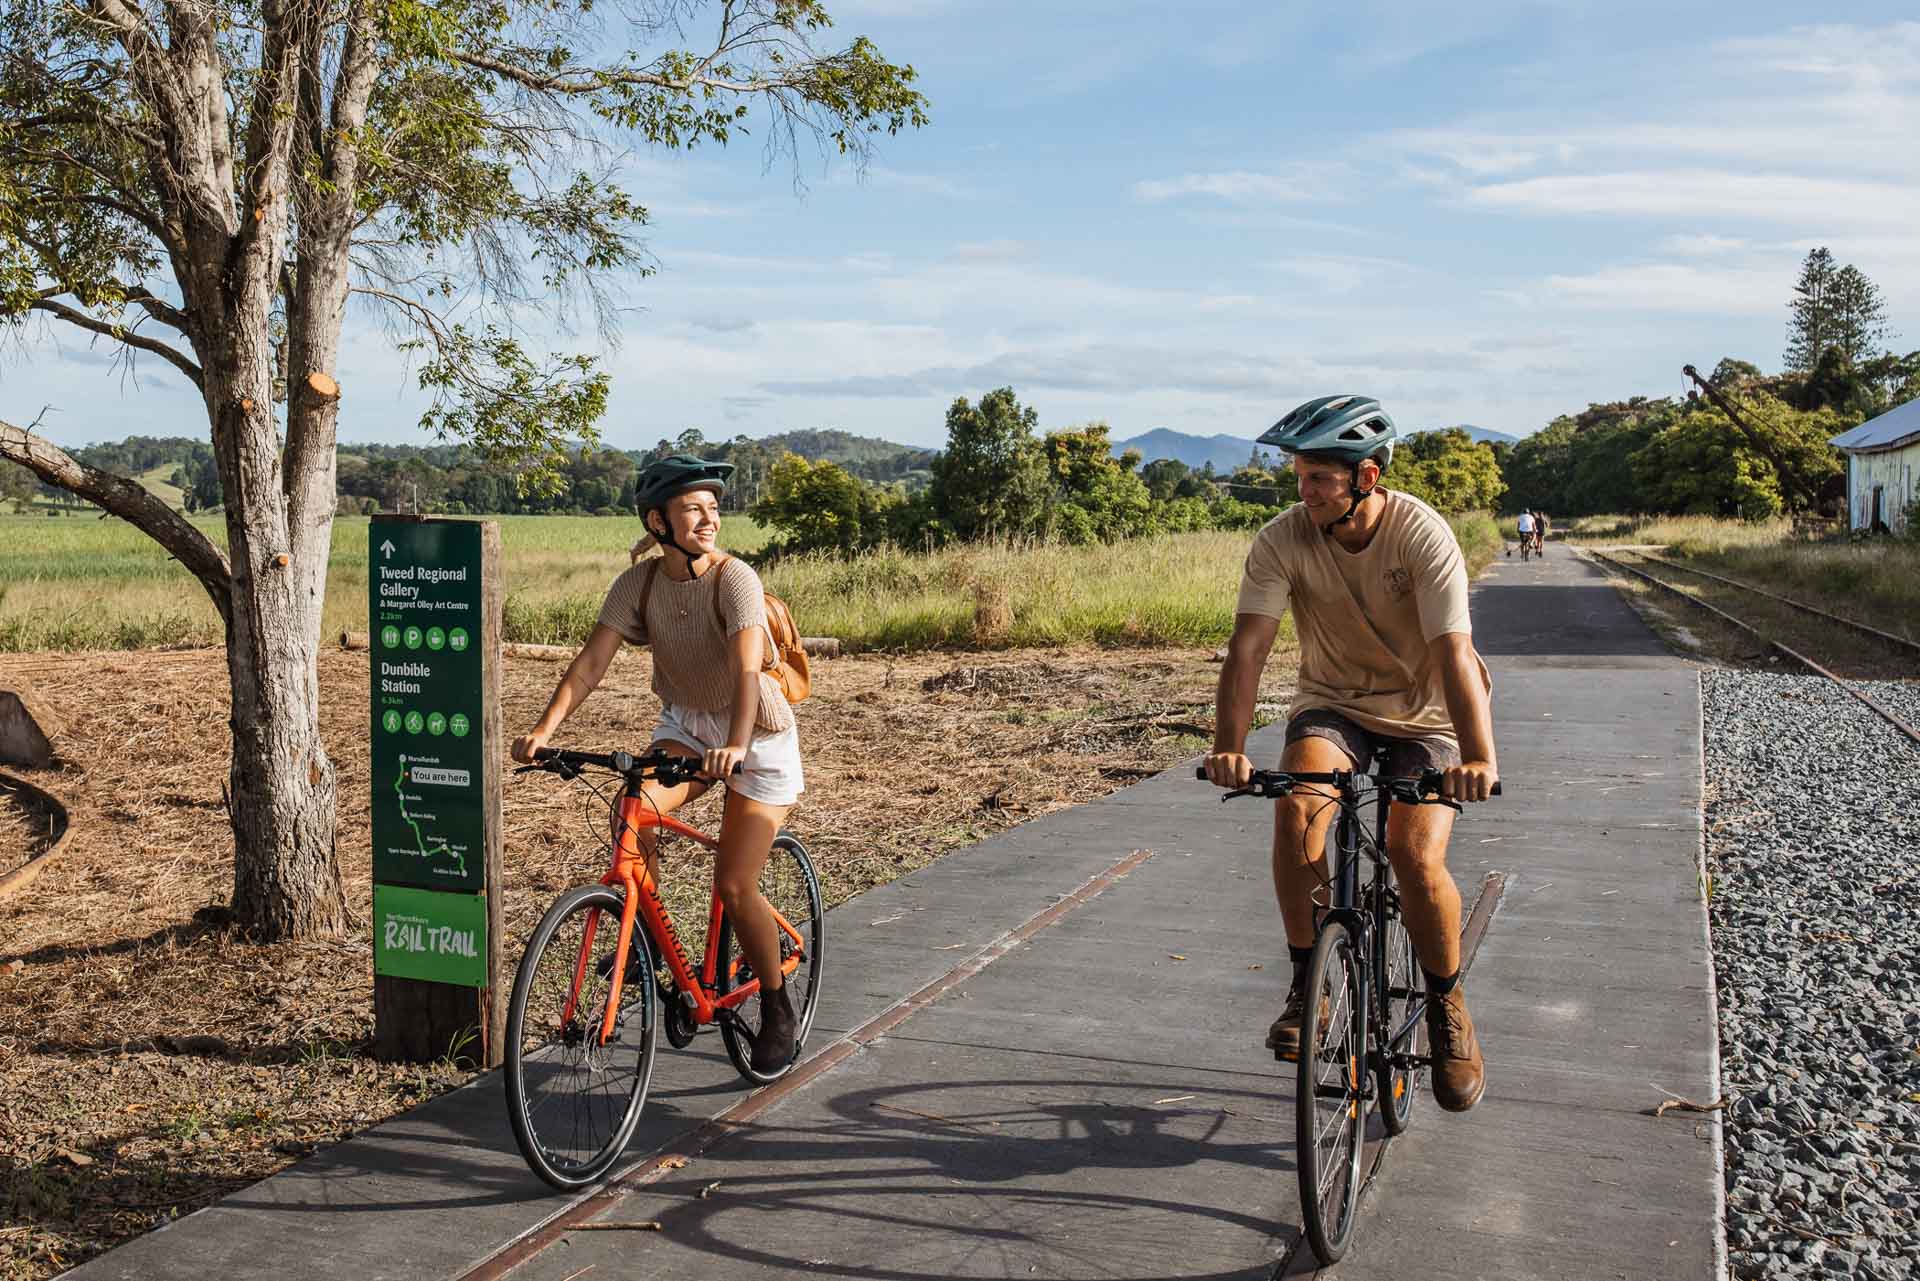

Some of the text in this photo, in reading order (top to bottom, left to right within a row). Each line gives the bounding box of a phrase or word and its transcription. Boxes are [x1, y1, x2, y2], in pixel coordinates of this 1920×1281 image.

[380, 566, 466, 583] Tweed Regional
[380, 583, 419, 600] Gallery
[380, 600, 469, 610] & Margaret Olley Art Centre
[381, 662, 431, 677] Dunbible
[381, 679, 420, 694] Station
[414, 771, 468, 782] You are here
[384, 921, 477, 957] RAIL TRAIL
